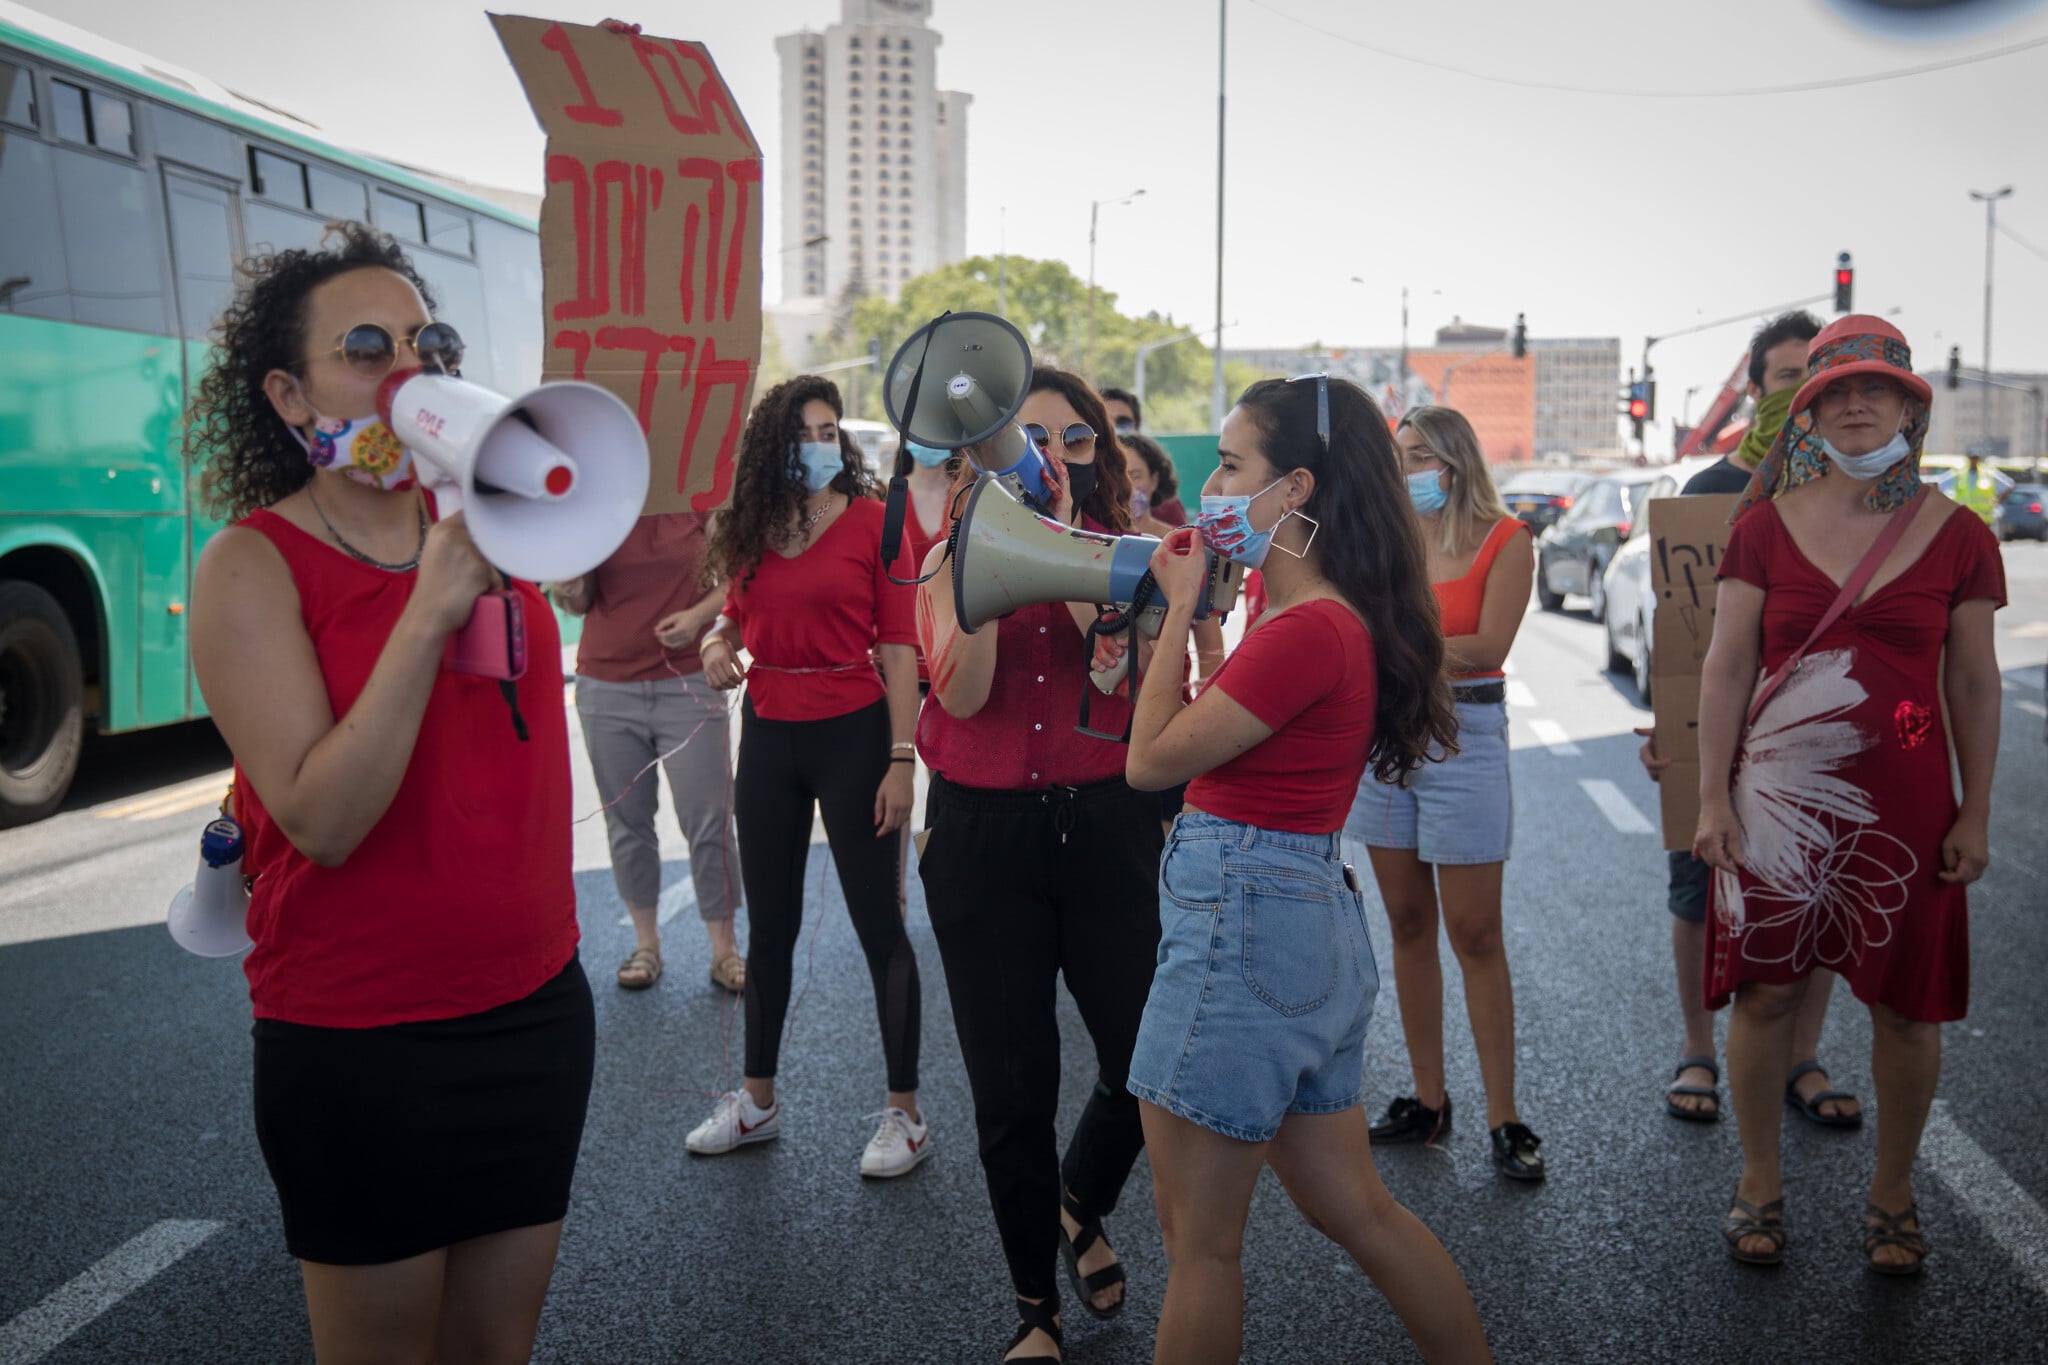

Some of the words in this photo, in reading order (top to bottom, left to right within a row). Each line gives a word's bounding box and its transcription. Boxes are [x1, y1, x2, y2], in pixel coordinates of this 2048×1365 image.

[631, 36, 749, 147] גם
[546, 154, 664, 322] יותר
[677, 157, 761, 323] זה
